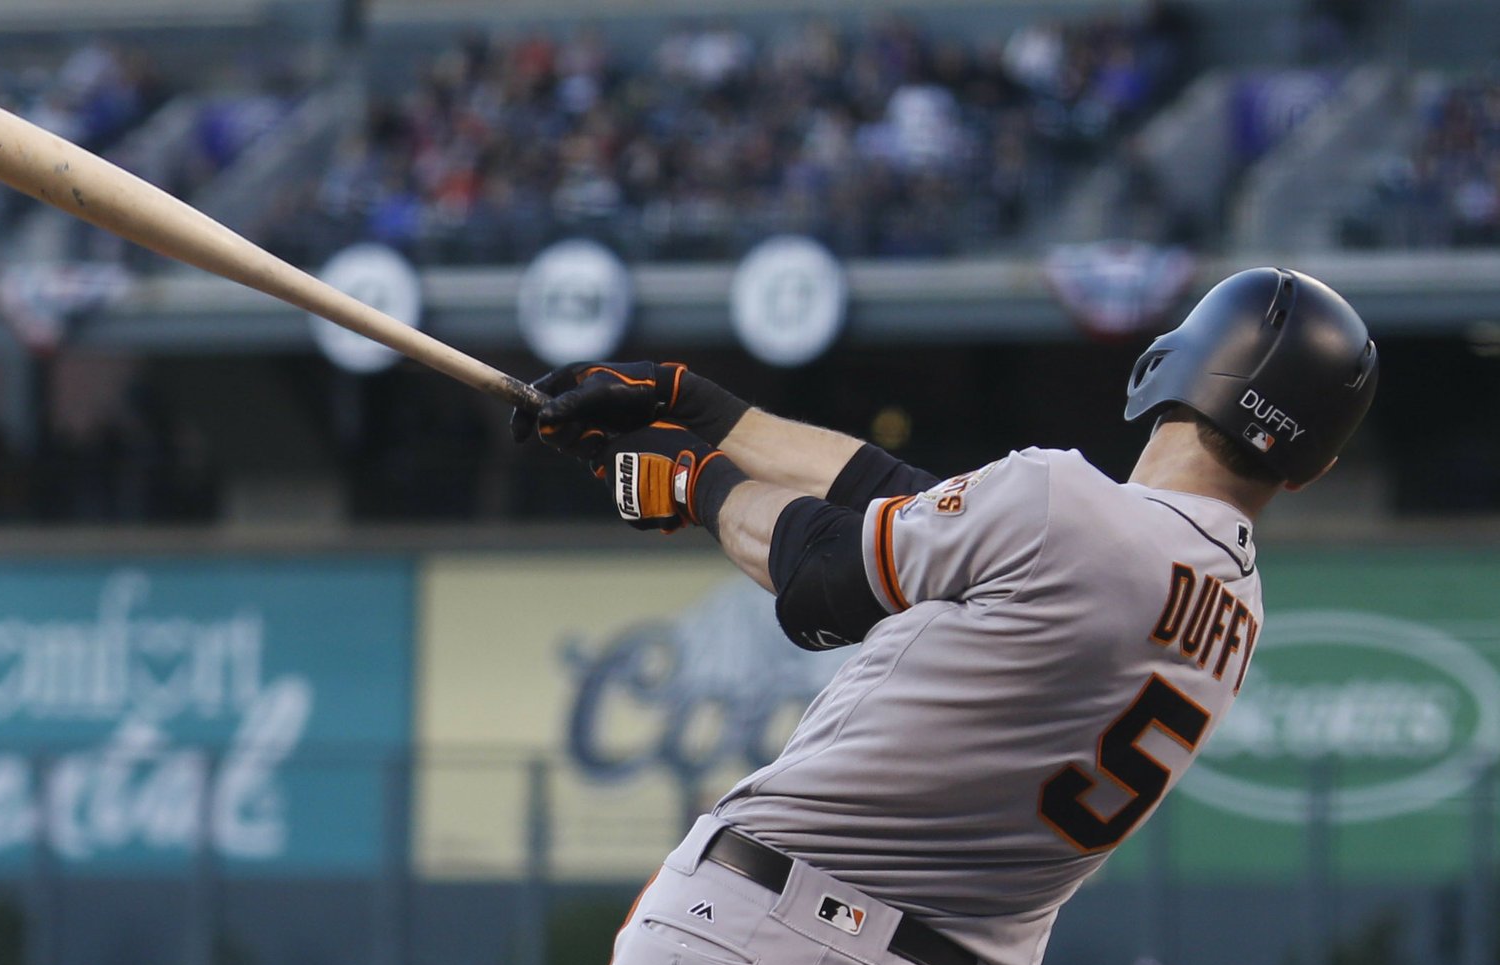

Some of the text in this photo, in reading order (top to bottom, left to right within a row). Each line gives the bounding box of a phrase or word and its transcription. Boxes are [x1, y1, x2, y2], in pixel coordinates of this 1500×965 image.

[1239, 389, 1305, 442] DUFFY
[1148, 560, 1258, 697] DUFFY
[556, 622, 812, 800] Coo
[1037, 671, 1212, 853] 5
